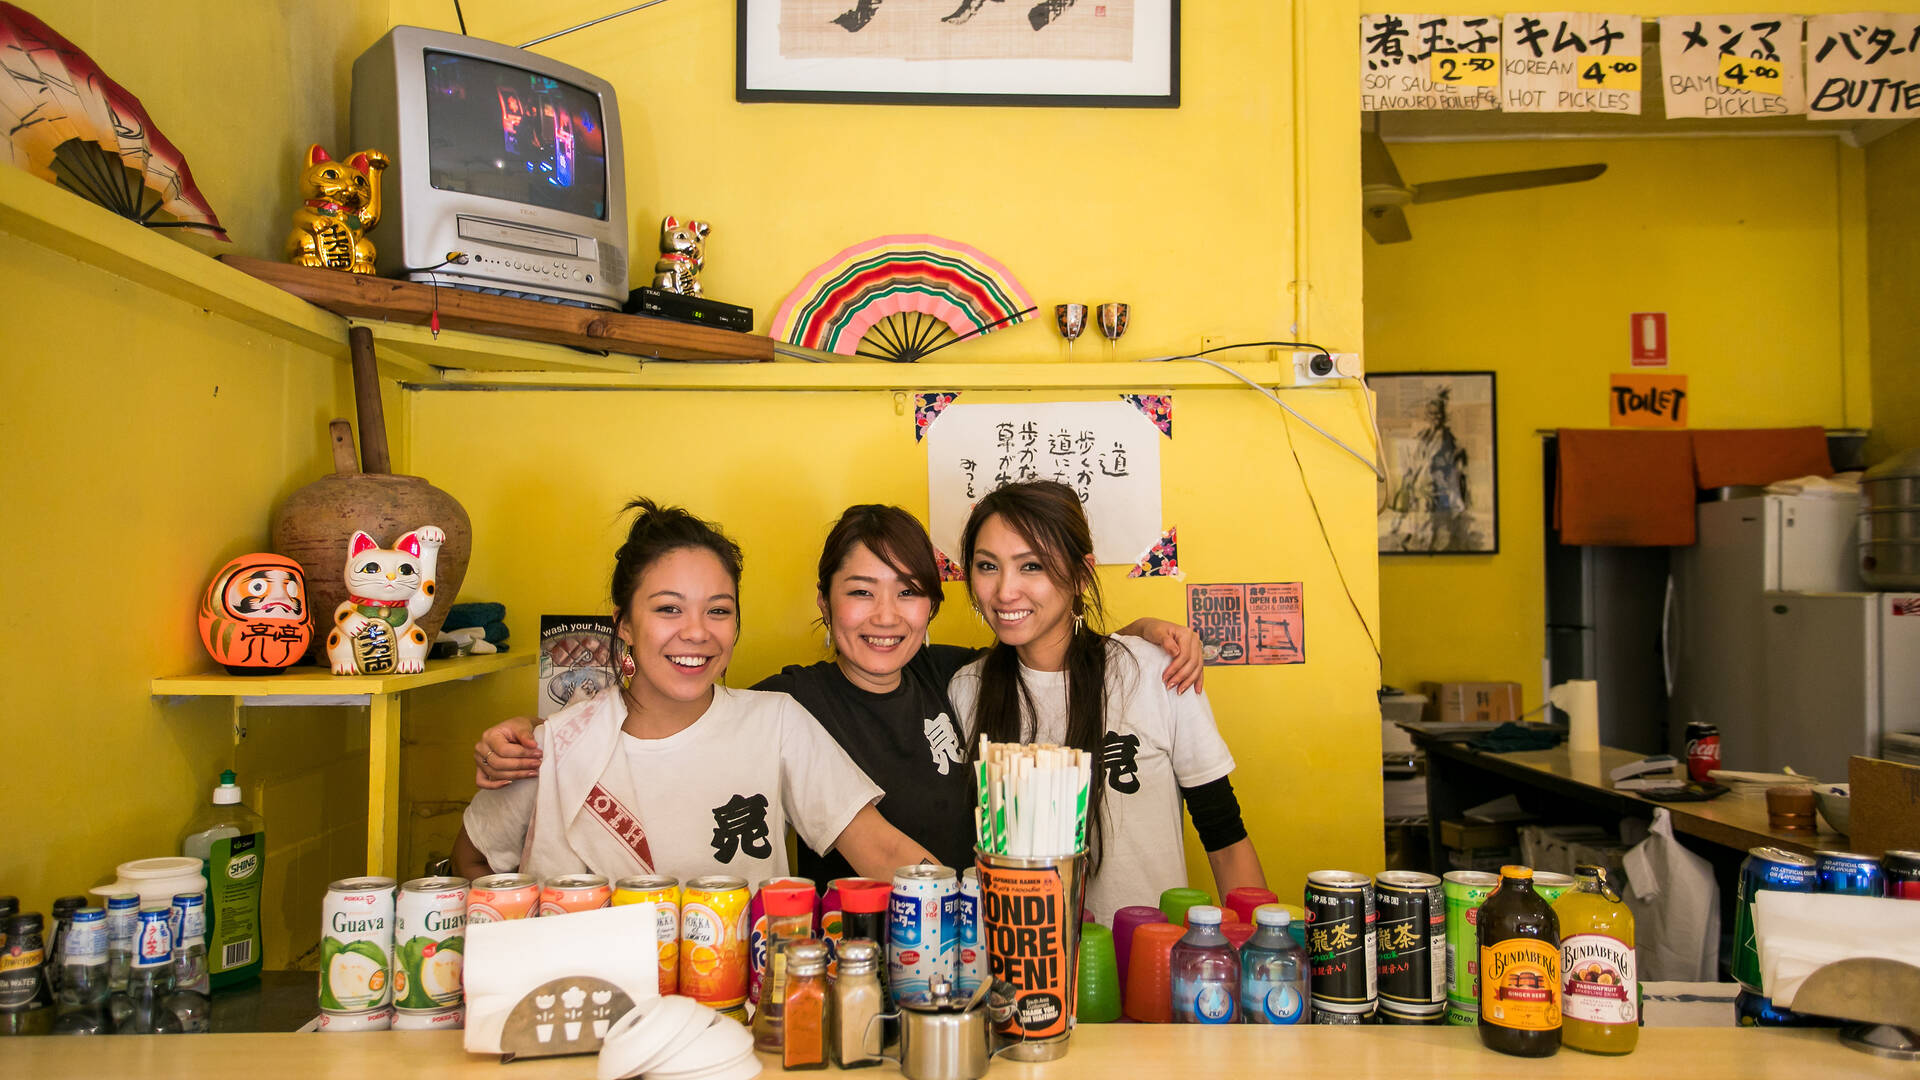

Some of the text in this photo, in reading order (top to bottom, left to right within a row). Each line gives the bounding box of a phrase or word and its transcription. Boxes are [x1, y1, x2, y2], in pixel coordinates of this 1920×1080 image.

[1513, 17, 1625, 57] キムチ
[1504, 58, 1575, 76] KOREAN
[1365, 74, 1457, 94] SOY SAUCE
[1508, 89, 1630, 111] HOT PICKLES
[1704, 96, 1789, 116] PICKLES
[1611, 386, 1686, 422] TOILET
[1075, 430, 1096, 504] 歩くから
[1098, 440, 1130, 477] 道
[1191, 596, 1241, 612] BONDI
[1249, 596, 1272, 605] OPEN
[1279, 595, 1299, 604] DAYS
[543, 622, 612, 637] wash your han
[1191, 611, 1241, 627] STORE
[588, 794, 645, 849] OTH
[230, 855, 256, 875] SHINE
[982, 891, 1056, 927] ONDI
[332, 911, 384, 933] Guava
[1489, 947, 1557, 985] BUNDABERG
[1561, 943, 1631, 981] BUNDABERG
[1507, 990, 1531, 998] GINGER
[1576, 983, 1617, 992] PASSIONFRUIT
